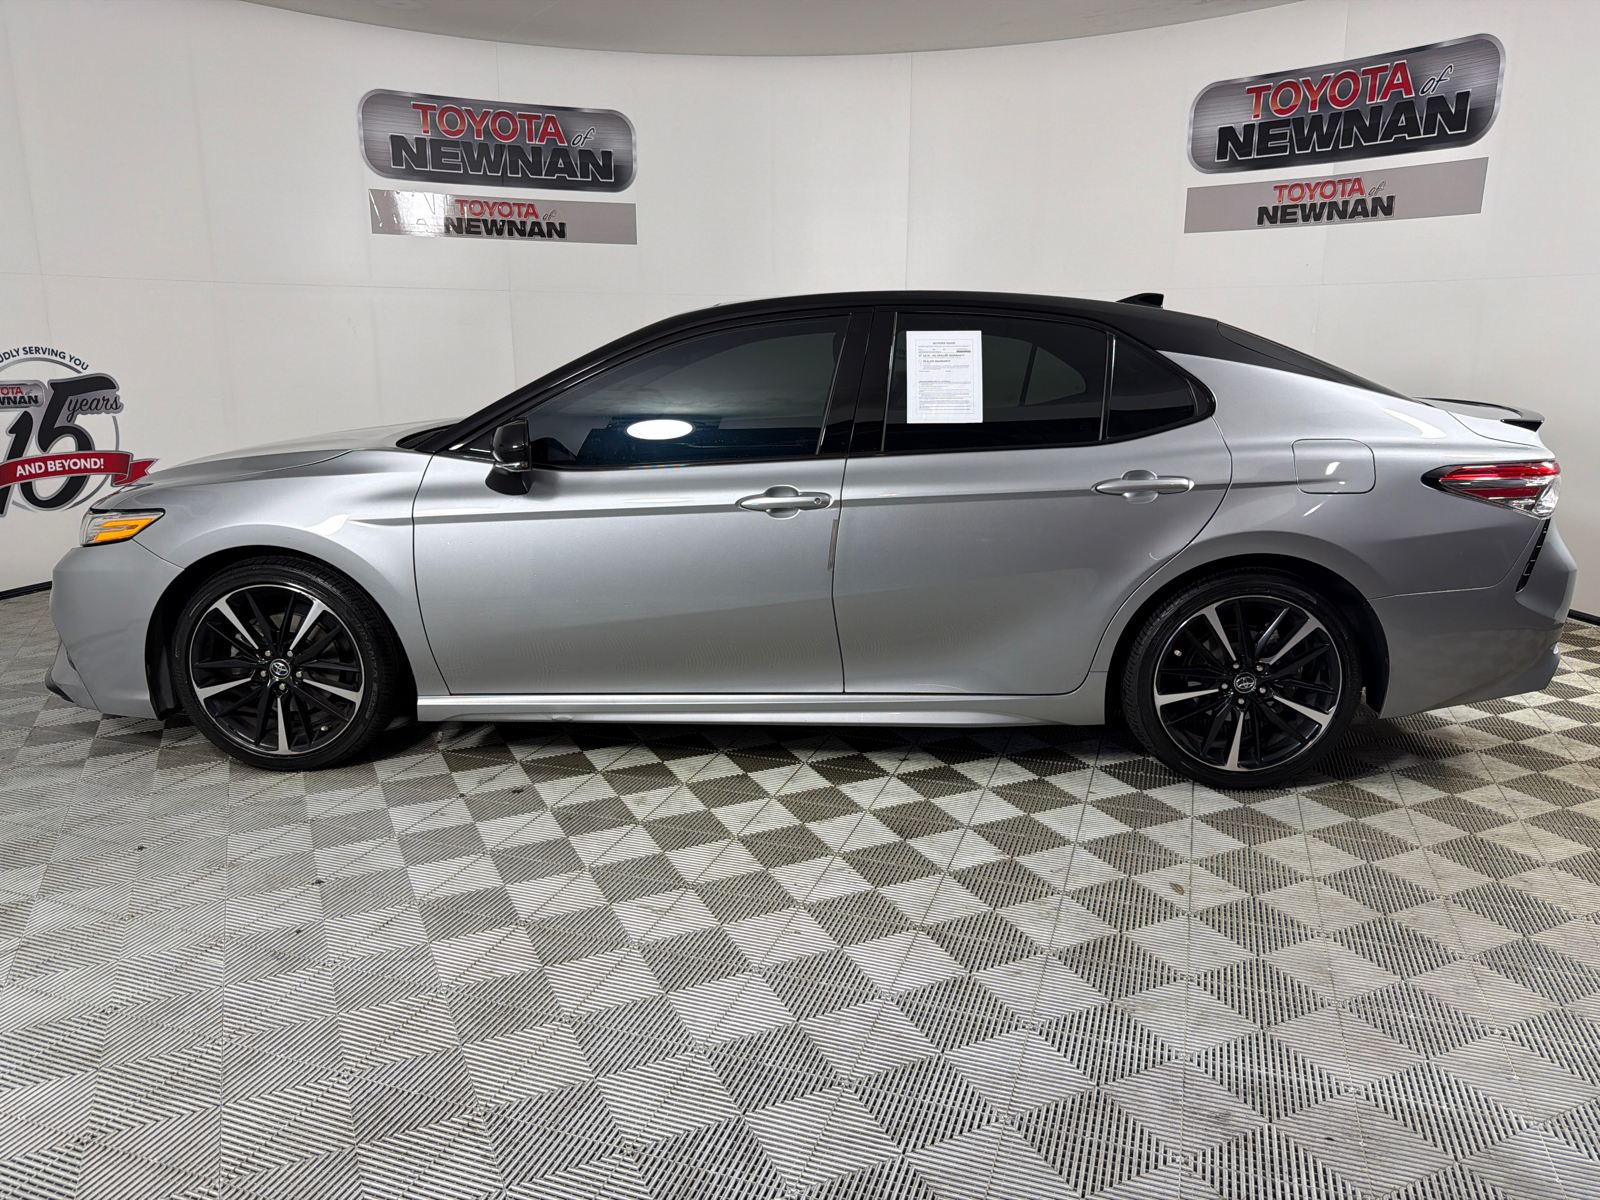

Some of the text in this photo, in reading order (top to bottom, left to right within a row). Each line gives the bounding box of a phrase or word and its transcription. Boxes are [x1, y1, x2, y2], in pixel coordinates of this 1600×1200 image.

[1246, 60, 1453, 120] TOYOTA of
[411, 101, 596, 147] TOYOTA of
[1214, 88, 1472, 162] NEWNAN
[389, 134, 615, 182] NEWNAN
[1273, 176, 1386, 204] TOYOTA of
[455, 199, 557, 221] TOYOTA of
[1256, 195, 1395, 226] NEWNAN
[444, 216, 566, 239] NEWNAN
[22, 346, 66, 360] SERVING
[69, 354, 89, 371] YOU
[0, 386, 33, 396] OTA of
[66, 395, 122, 423] years
[16, 458, 104, 477] AND BEYOND!
